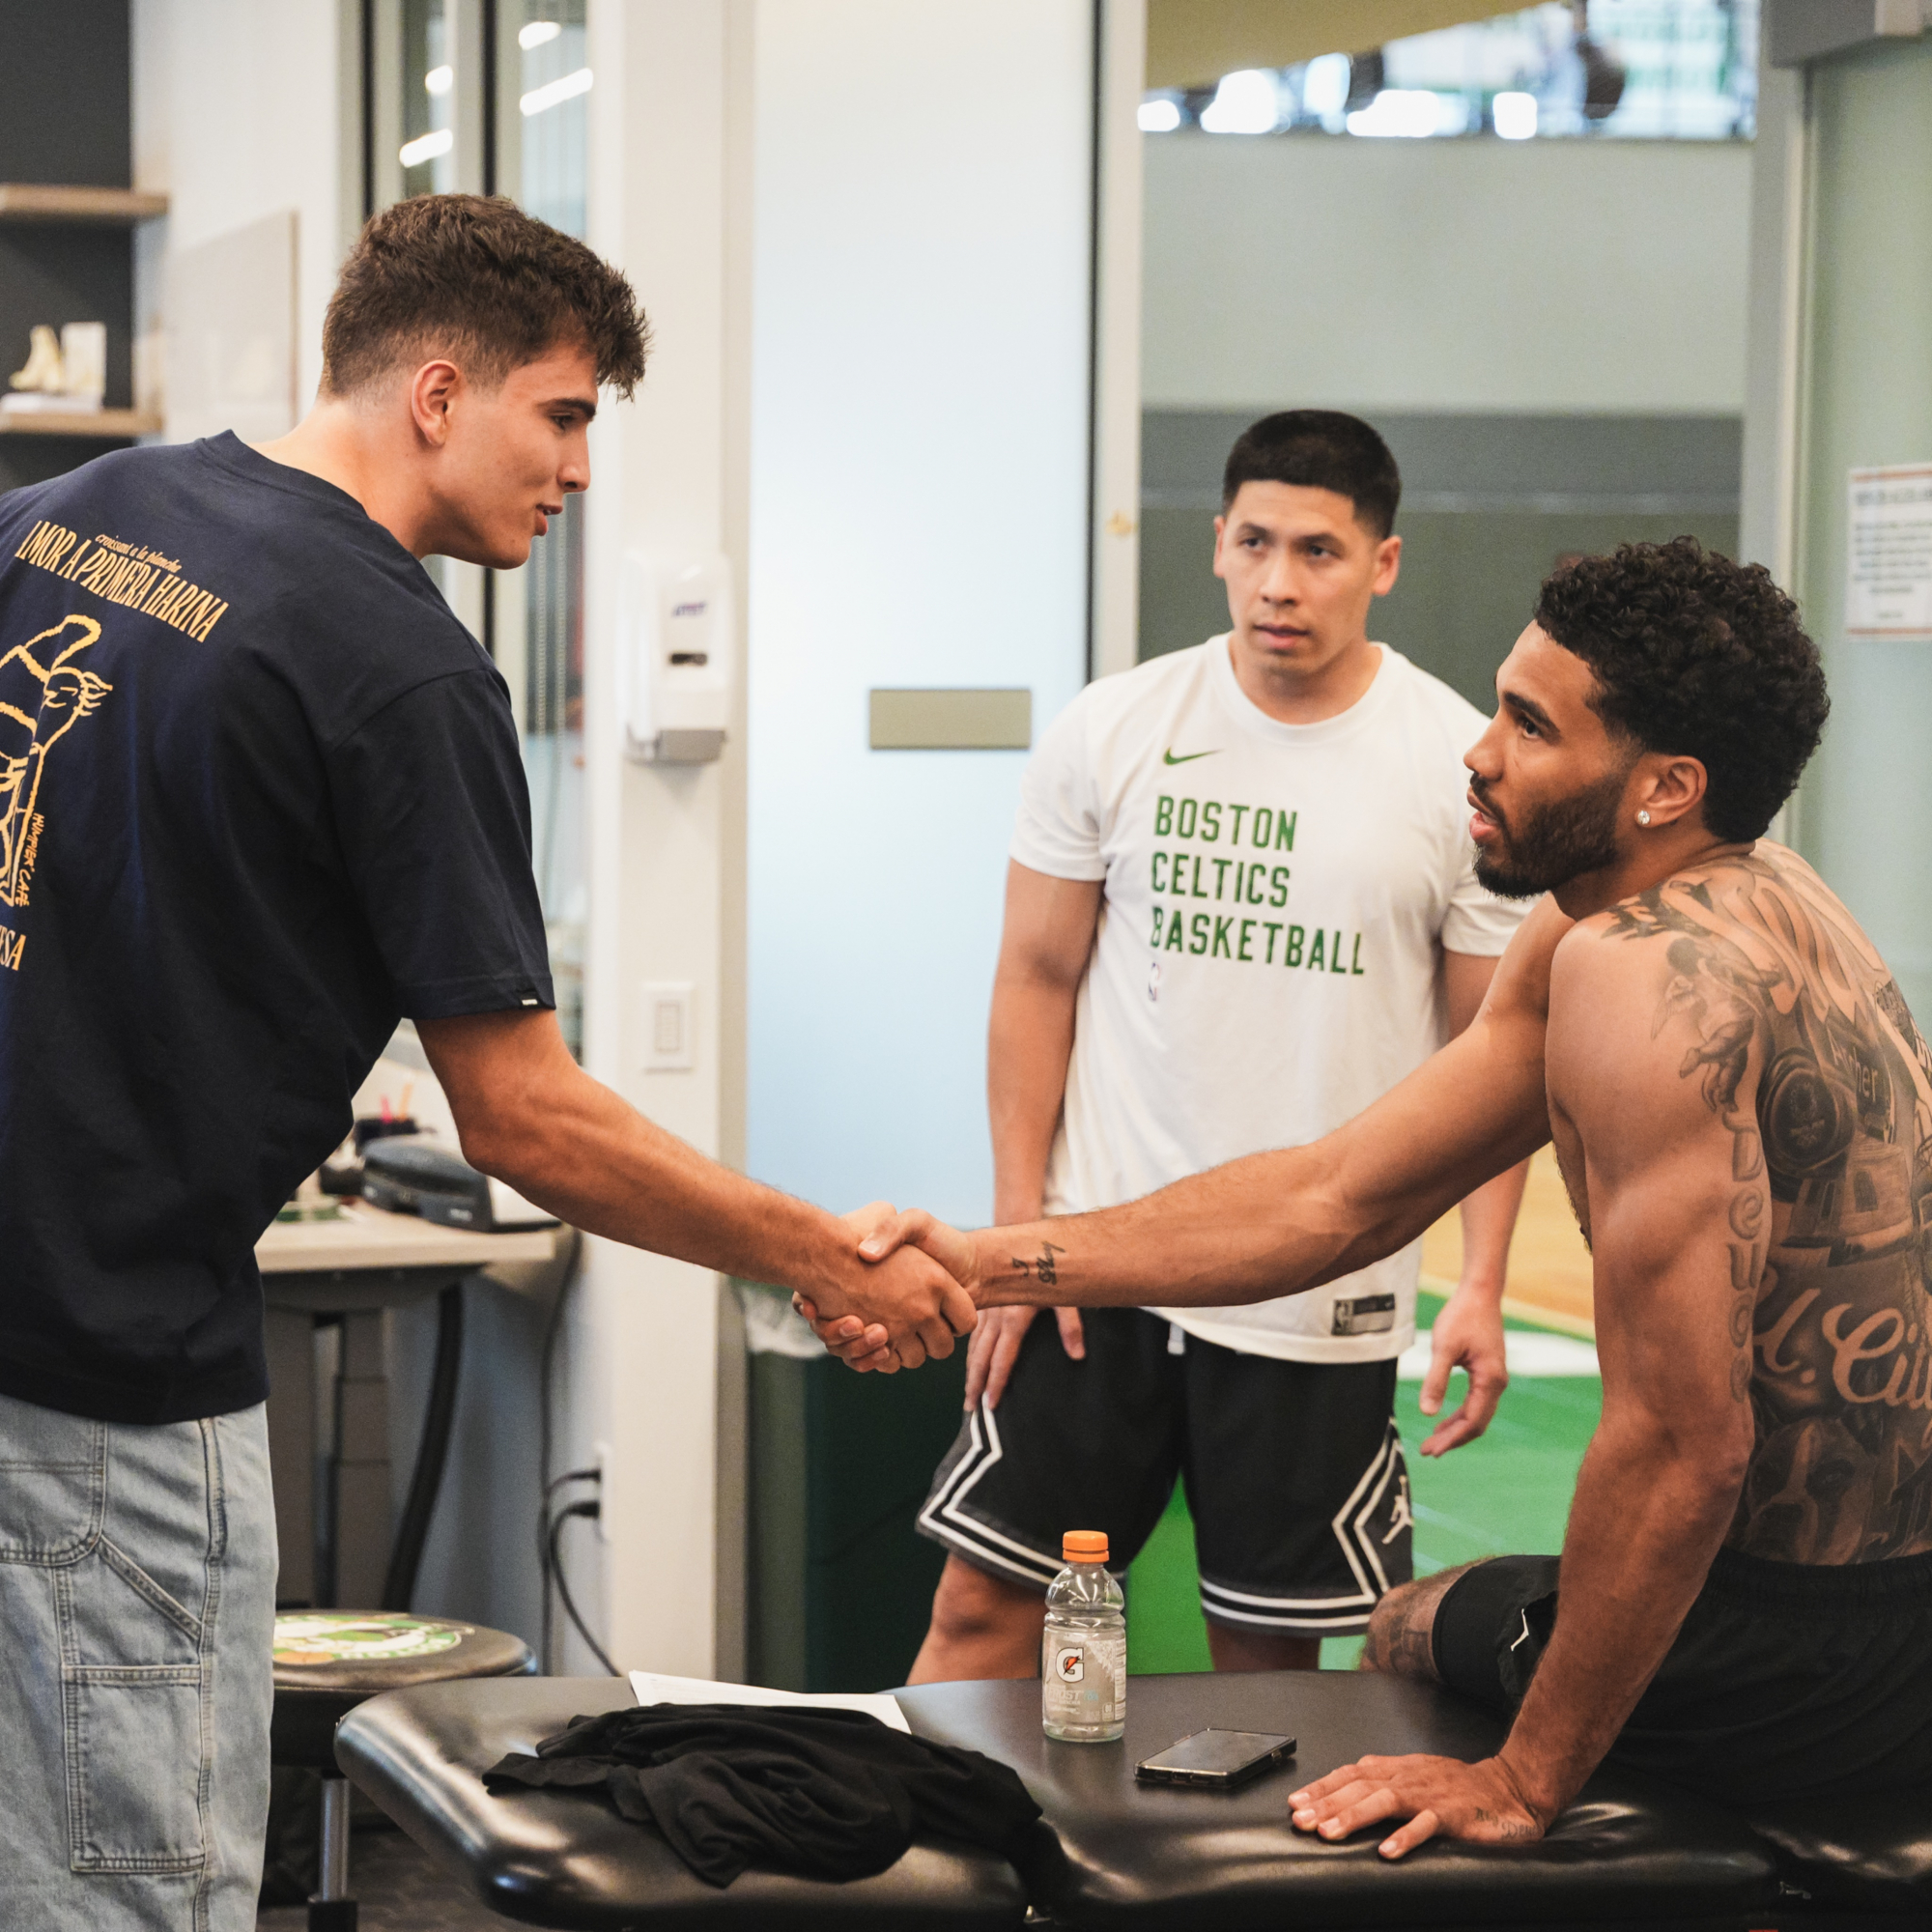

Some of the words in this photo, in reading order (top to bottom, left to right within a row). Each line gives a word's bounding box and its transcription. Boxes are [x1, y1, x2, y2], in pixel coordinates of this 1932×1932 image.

[56, 538, 93, 580] A
[71, 547, 162, 610] PRIMERA
[128, 547, 139, 557] a
[139, 573, 230, 643] HARINA
[1153, 795, 1298, 852] BOSTON
[1151, 850, 1291, 908] CELTICS
[1150, 905, 1365, 976] BASKETBALL
[1055, 1646, 1085, 1684] G
